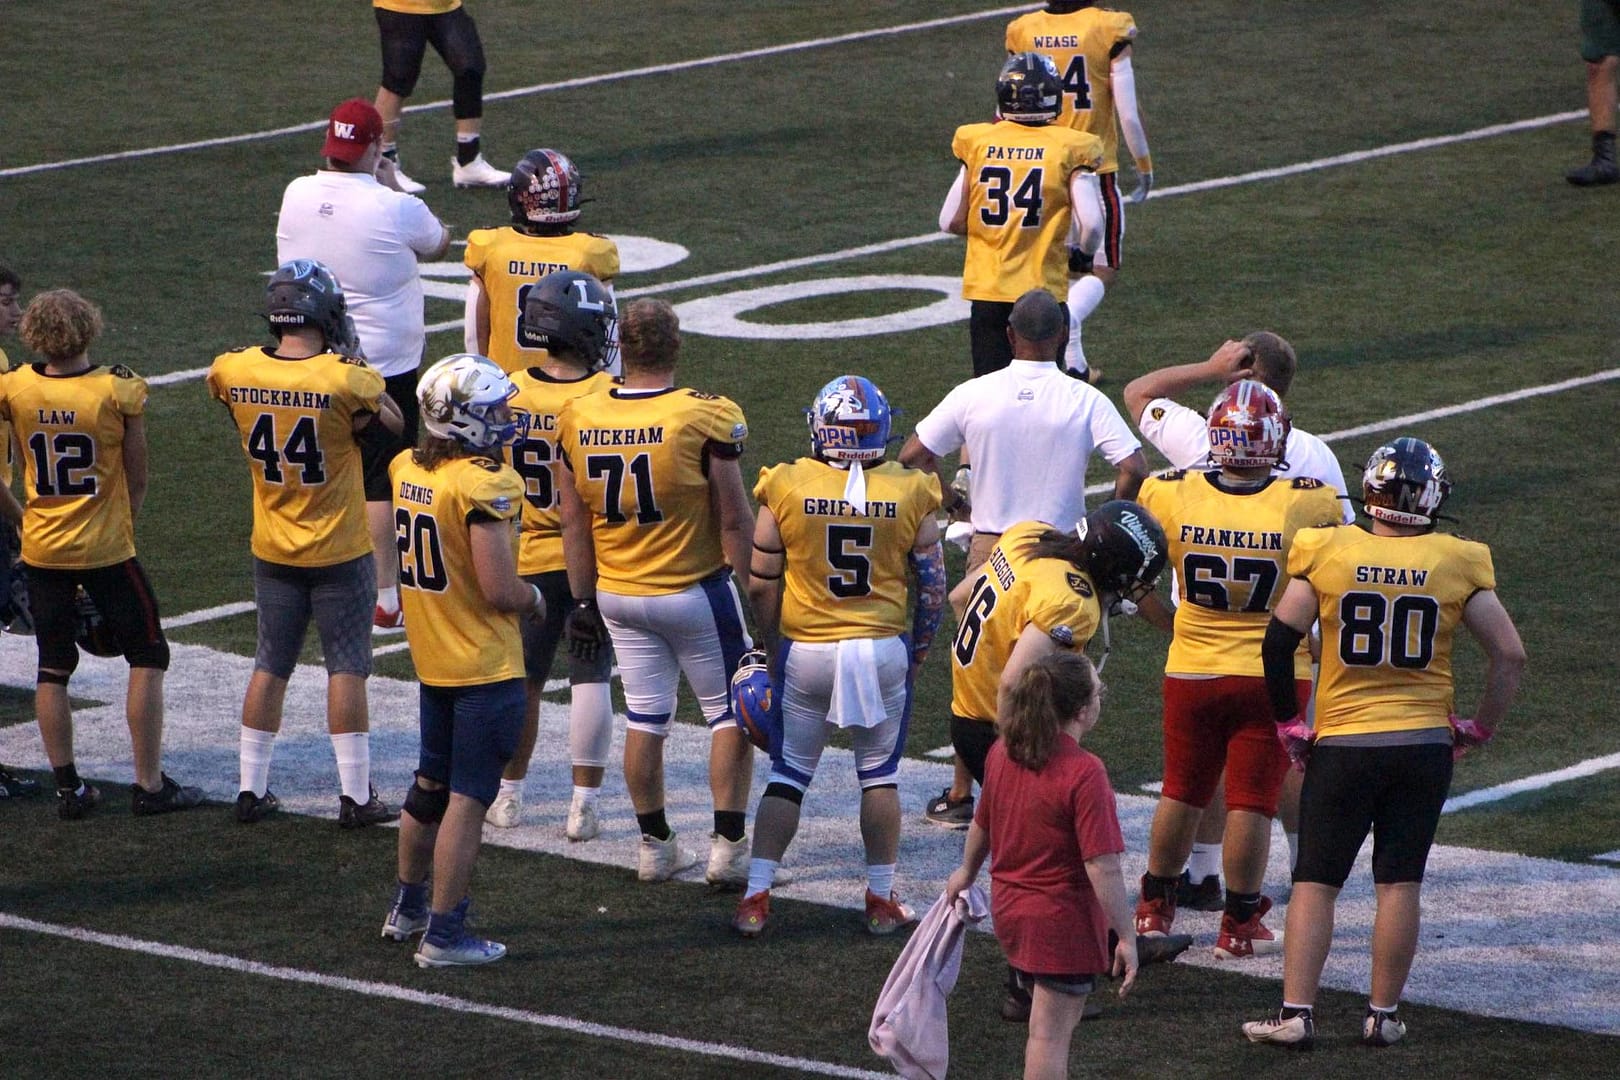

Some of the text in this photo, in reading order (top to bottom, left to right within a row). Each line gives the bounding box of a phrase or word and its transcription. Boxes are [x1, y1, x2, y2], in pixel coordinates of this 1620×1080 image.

[1034, 35, 1078, 48] WEASE
[1061, 55, 1092, 110] 4
[986, 146, 1044, 161] PAYTON
[979, 166, 1044, 229] 34
[572, 280, 604, 312] L
[269, 314, 305, 324] Riddell
[231, 387, 330, 409] STOCKRAHM
[39, 409, 75, 425] LAW
[514, 413, 560, 431] MAC
[248, 413, 326, 485] 44
[579, 427, 663, 446] WICKHAM
[1210, 428, 1248, 447] OPH
[29, 432, 98, 496] 12
[838, 450, 877, 460] Riddell
[1221, 457, 1268, 466] MARSHALL
[512, 437, 561, 511] 6
[400, 481, 433, 506] DENNIS
[586, 452, 664, 526] 71
[395, 507, 448, 593] 20
[1180, 525, 1282, 551] FRANKLIN
[826, 524, 874, 600] 5
[1183, 553, 1280, 613] 67
[1356, 566, 1428, 587] STRAW
[1339, 591, 1440, 670] 80
